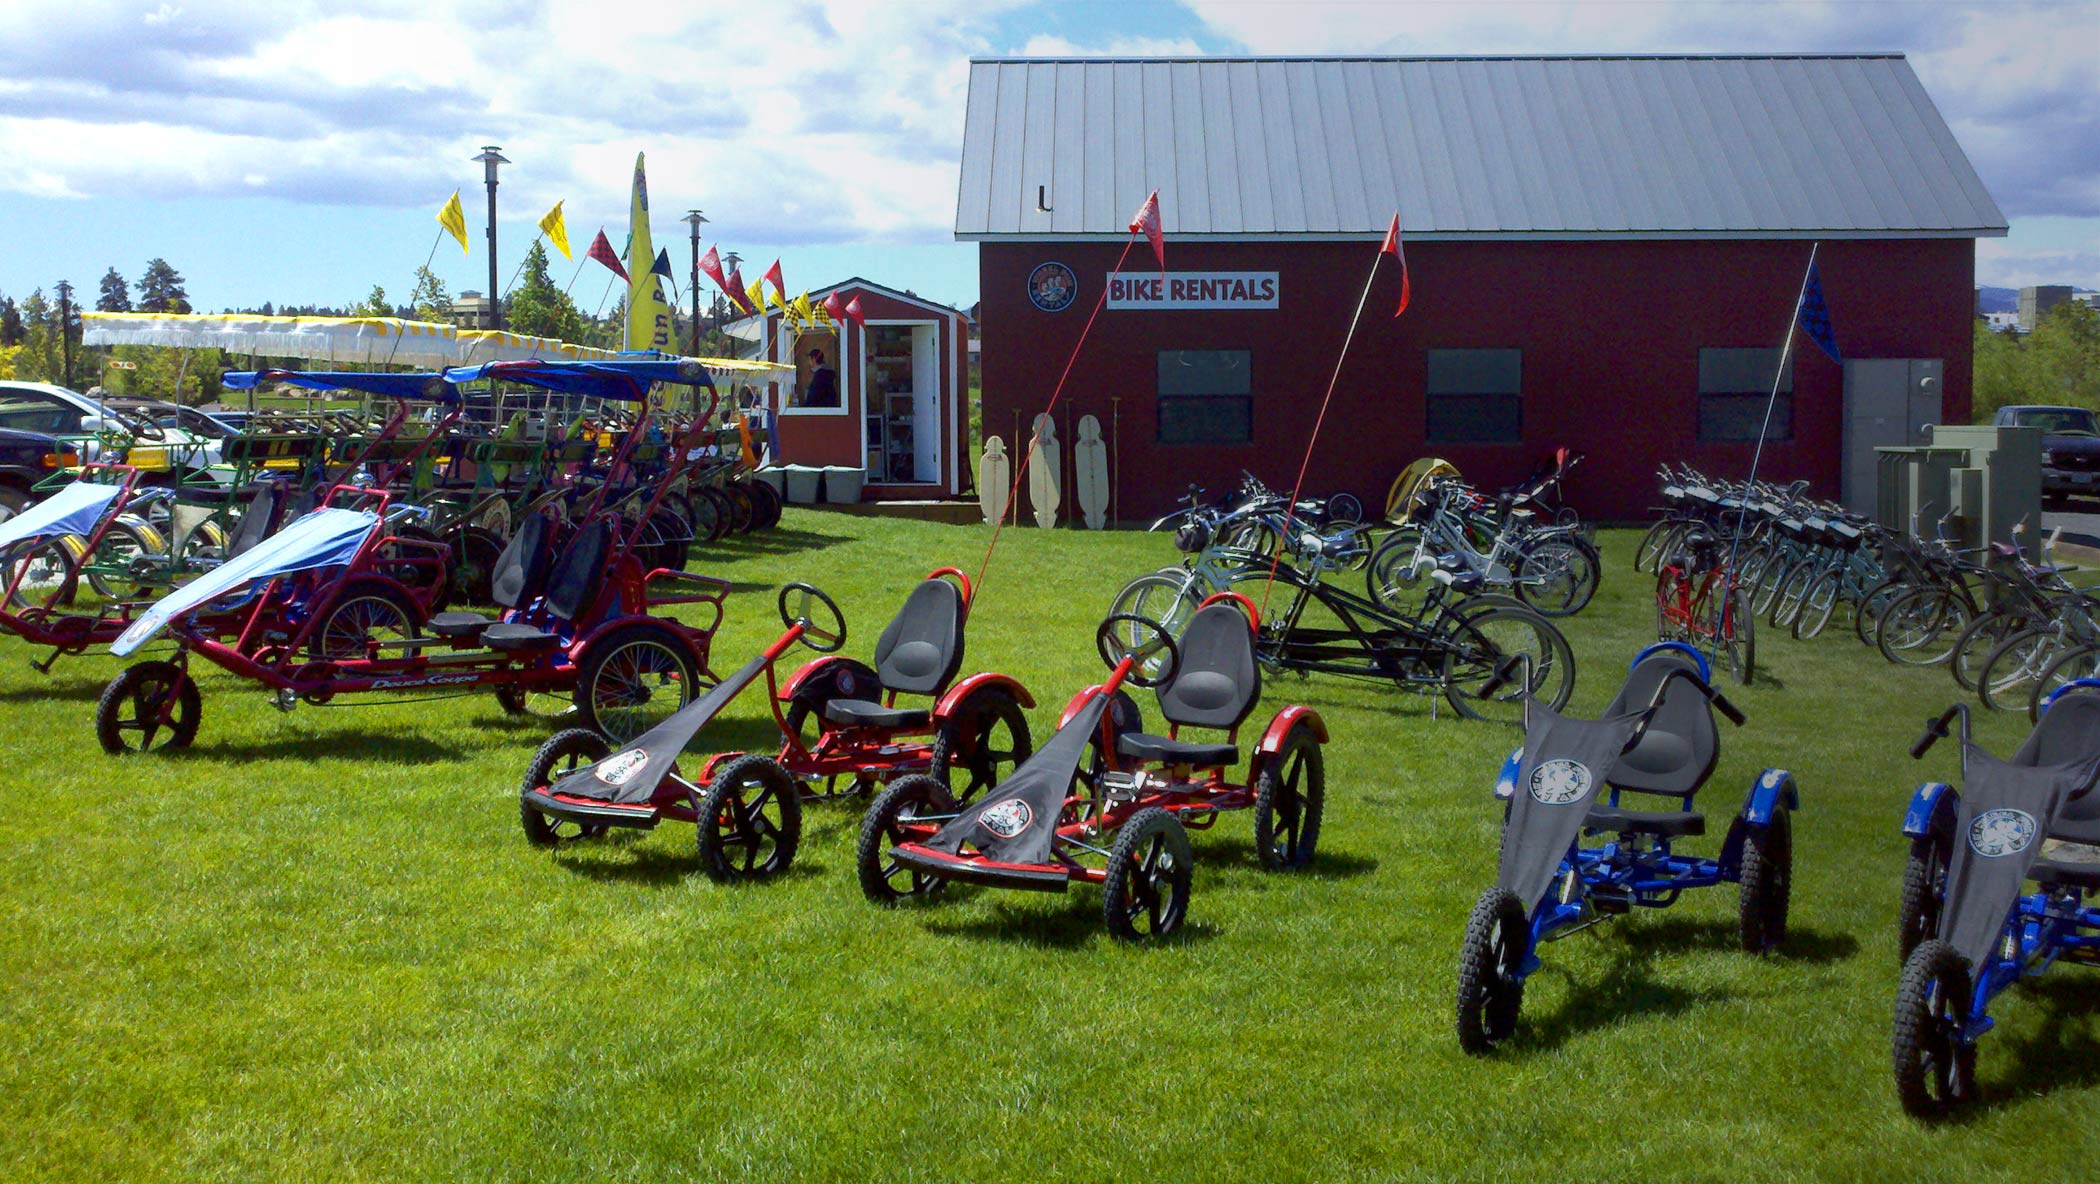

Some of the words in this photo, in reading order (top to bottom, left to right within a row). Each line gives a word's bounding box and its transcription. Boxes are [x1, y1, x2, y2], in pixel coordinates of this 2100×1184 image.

[1110, 279, 1163, 301] BIKE
[1170, 279, 1275, 301] RENTALS
[427, 674, 480, 685] Coupe
